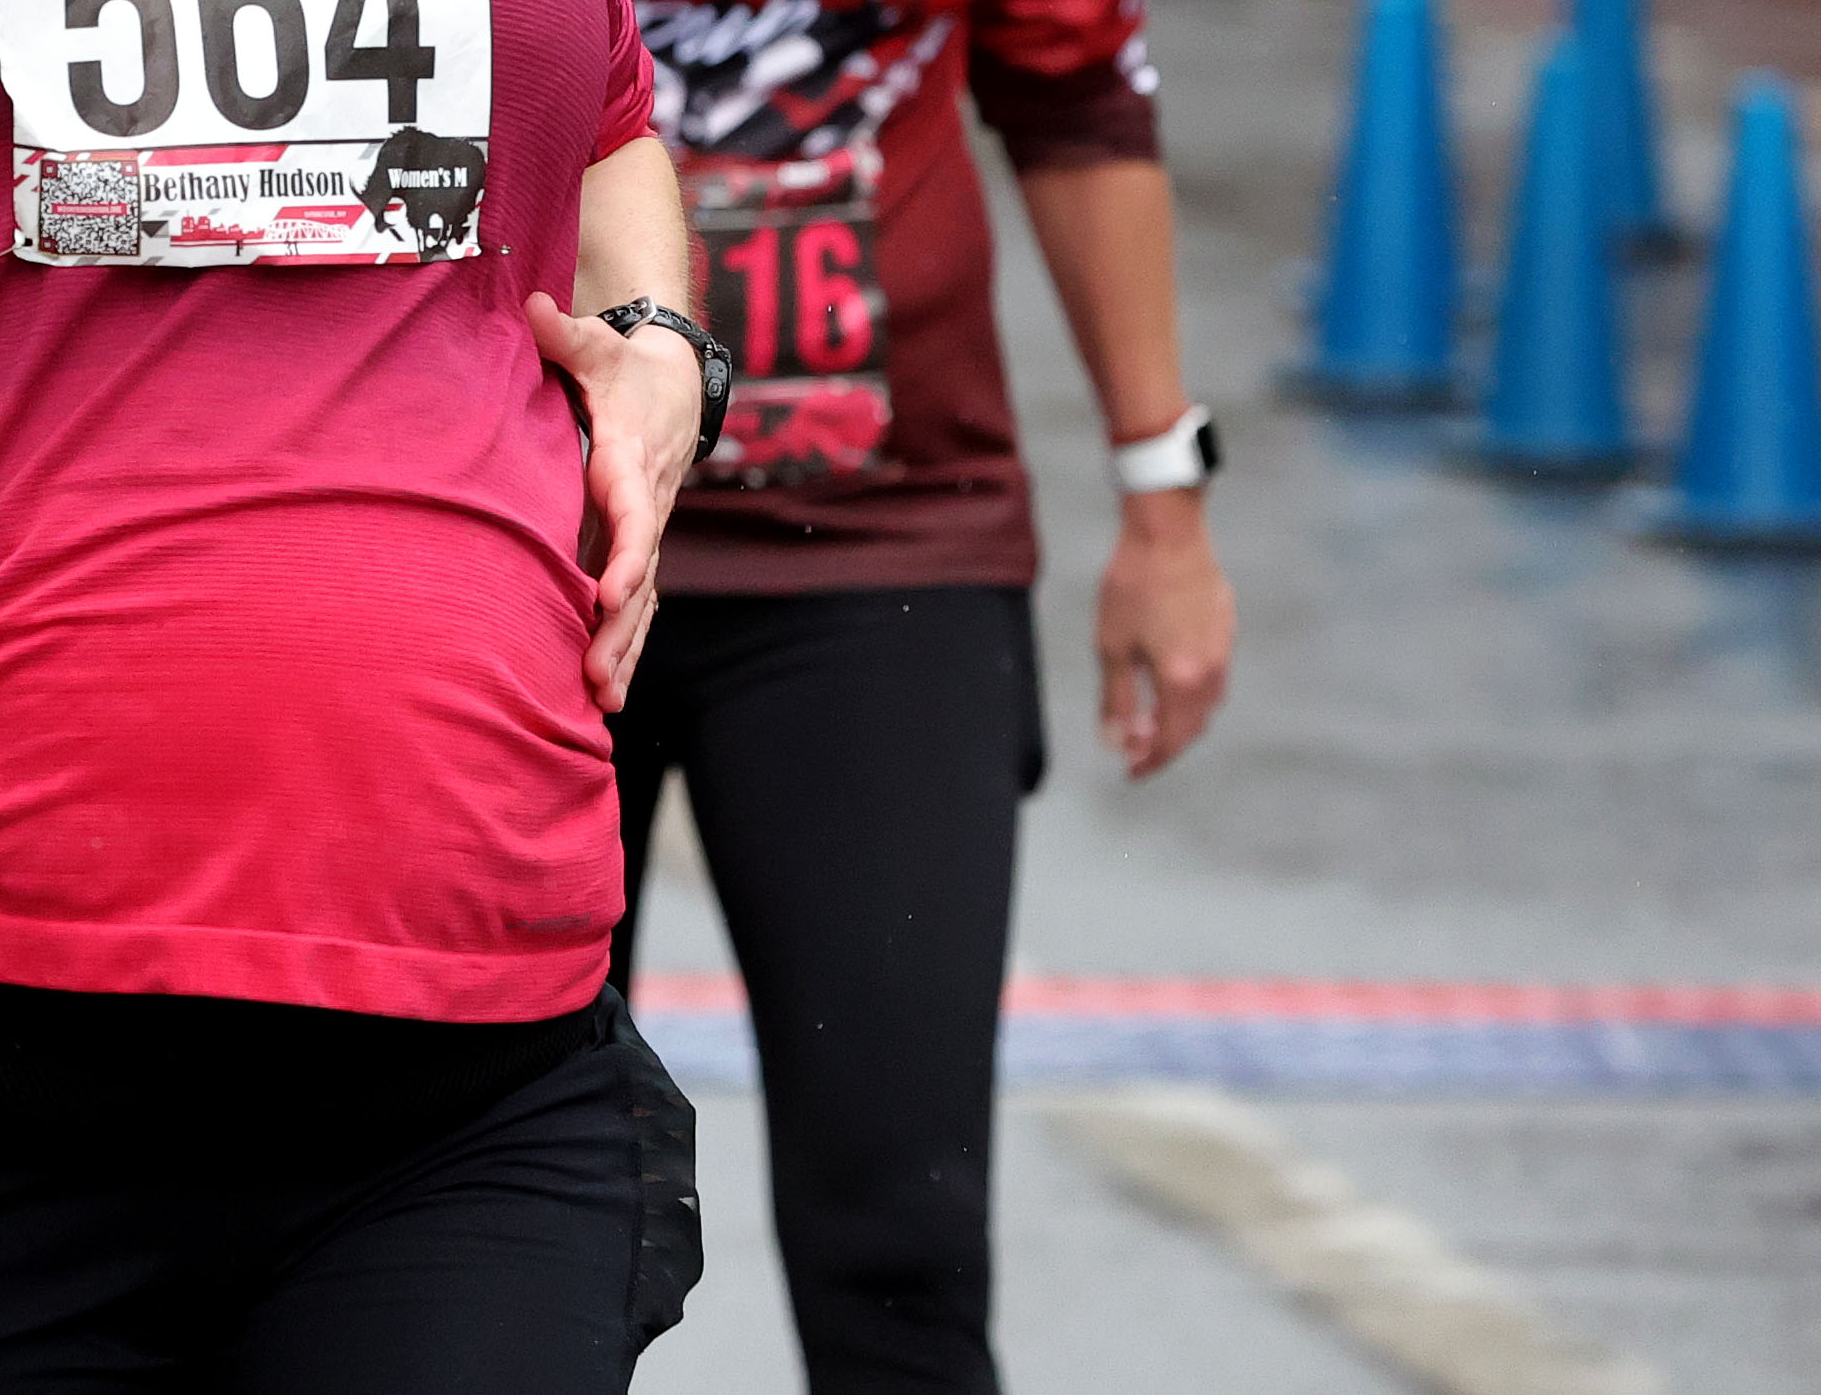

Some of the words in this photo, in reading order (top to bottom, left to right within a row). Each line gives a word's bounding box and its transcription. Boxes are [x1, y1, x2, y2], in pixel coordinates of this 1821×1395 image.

[143, 169, 249, 203] Bethany
[259, 168, 345, 198] Hudson
[387, 167, 451, 189] Women's
[454, 167, 468, 187] M
[690, 217, 875, 378] 16
